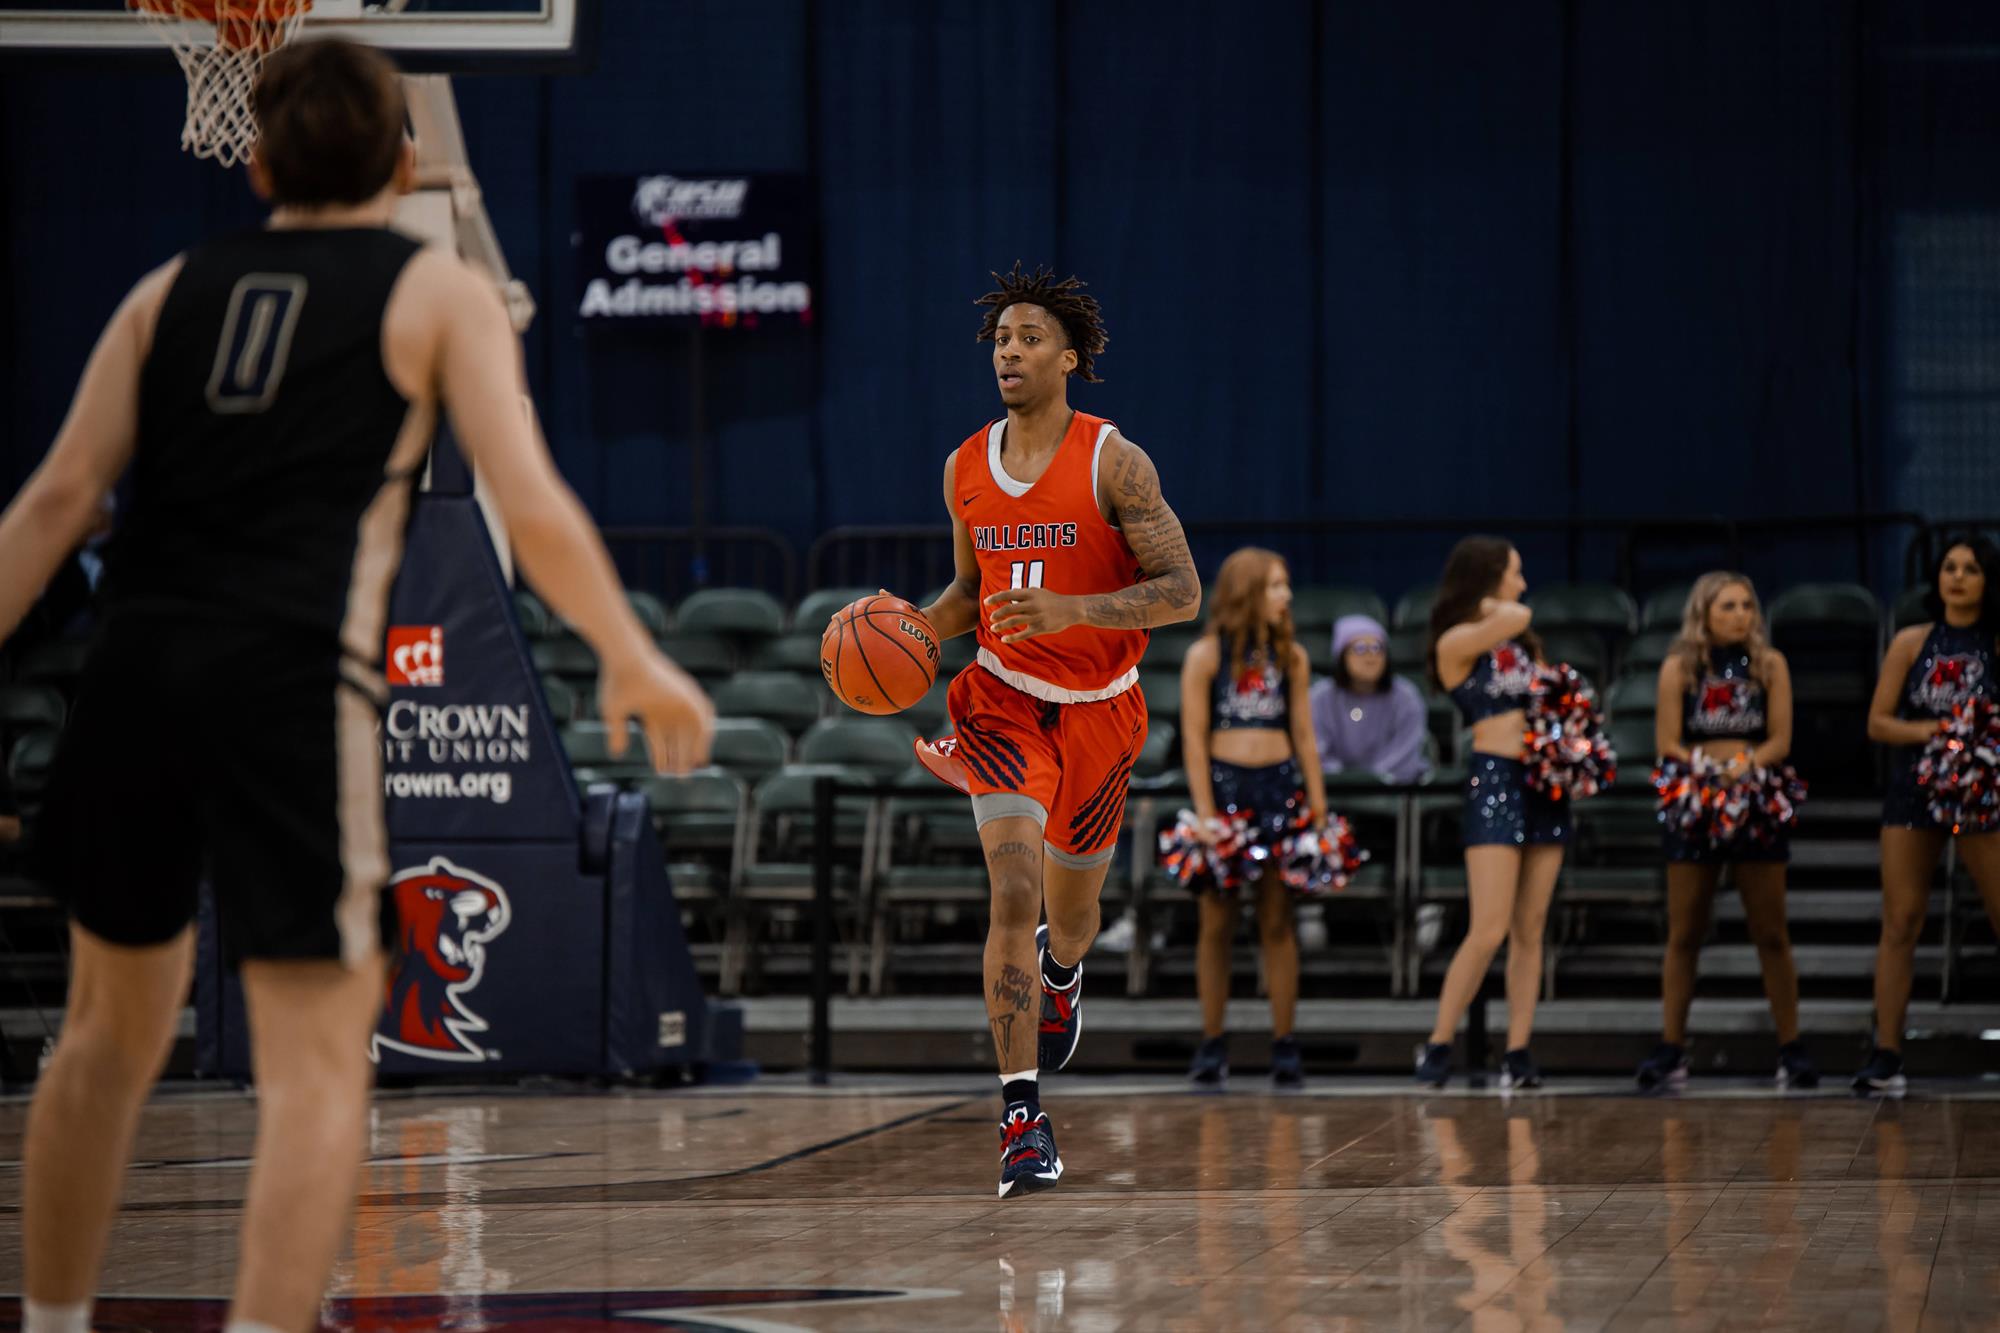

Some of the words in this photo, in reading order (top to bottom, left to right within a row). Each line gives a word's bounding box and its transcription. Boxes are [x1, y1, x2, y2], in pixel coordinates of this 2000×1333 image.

[605, 232, 781, 274] General
[580, 275, 809, 317] Admission
[204, 272, 309, 415] 0
[1010, 559, 1045, 594] 11
[899, 619, 941, 673] ilson
[387, 700, 529, 739] CROWN
[428, 739, 530, 763] UNION
[385, 772, 512, 803] rown.org
